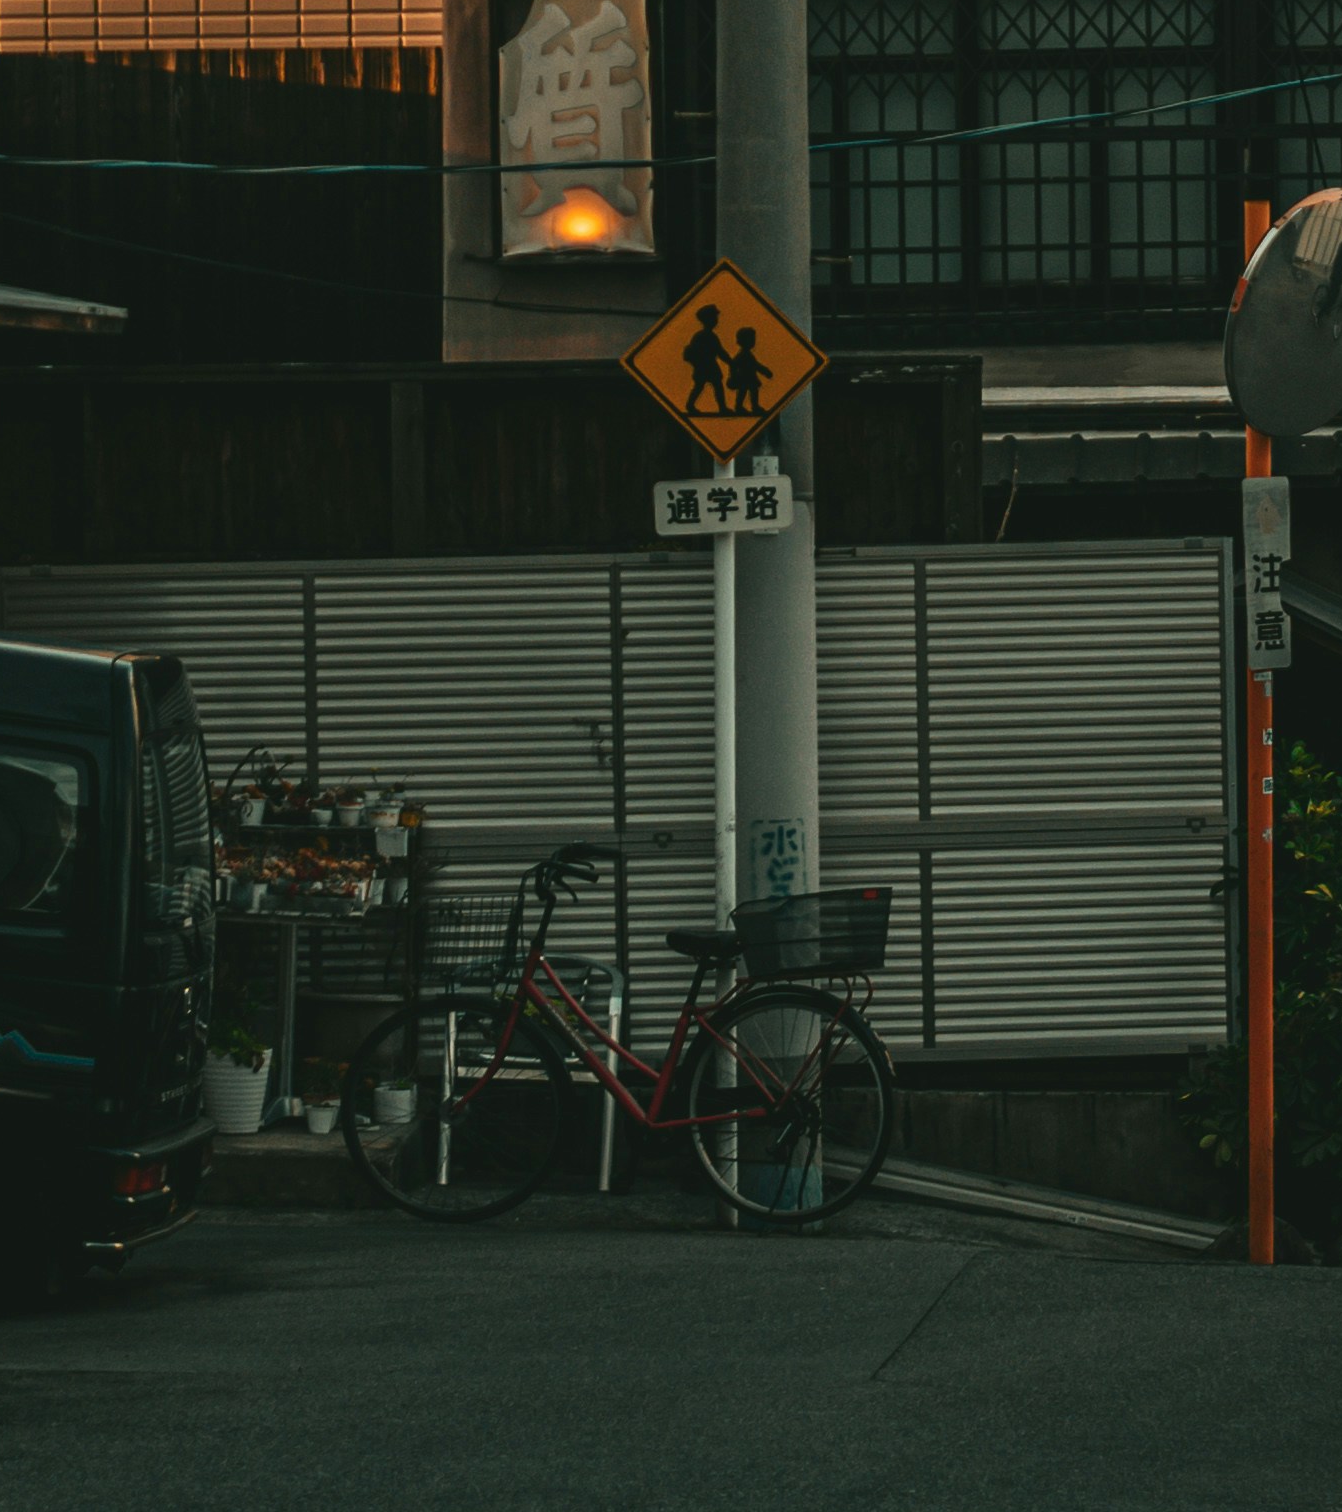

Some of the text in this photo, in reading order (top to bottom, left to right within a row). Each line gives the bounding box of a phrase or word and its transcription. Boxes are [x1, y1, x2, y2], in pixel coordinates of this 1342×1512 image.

[506, 0, 645, 217] 質
[667, 485, 778, 524] 通学路
[1252, 553, 1285, 651] 注意
